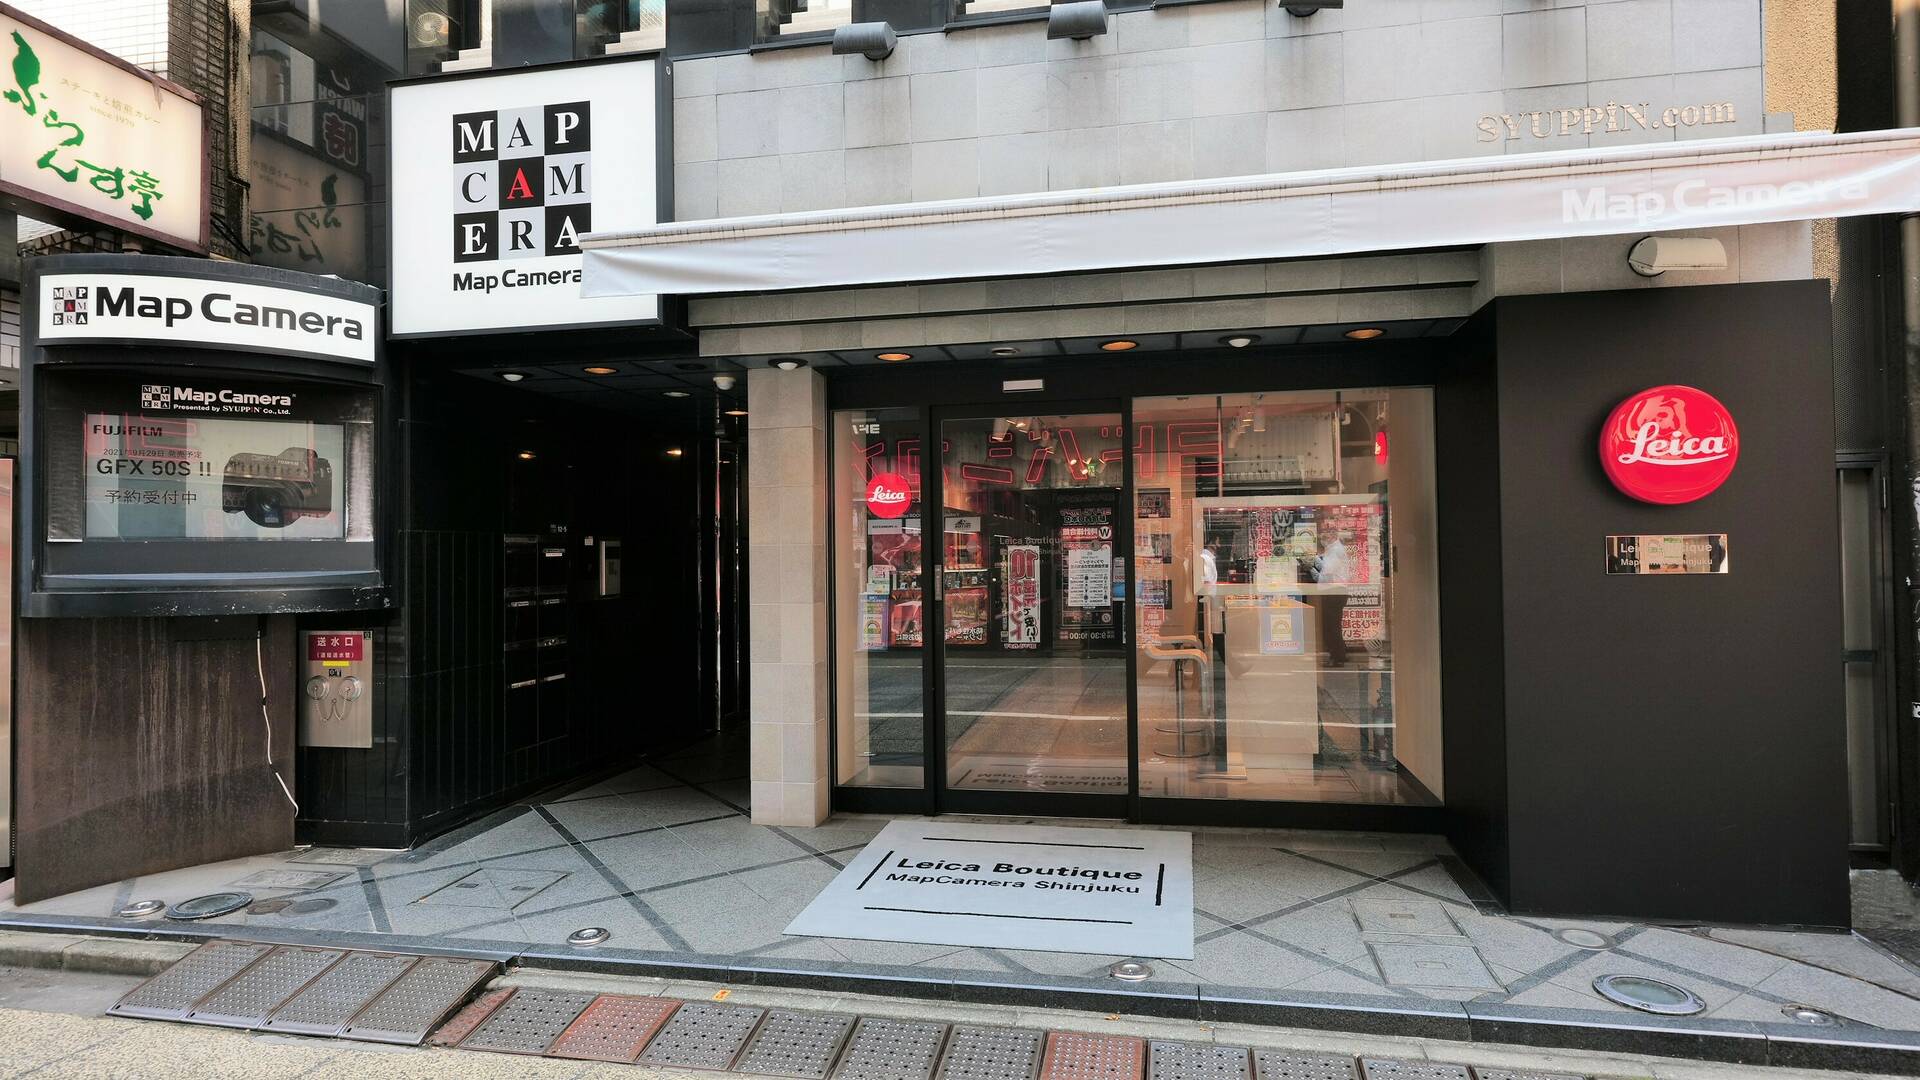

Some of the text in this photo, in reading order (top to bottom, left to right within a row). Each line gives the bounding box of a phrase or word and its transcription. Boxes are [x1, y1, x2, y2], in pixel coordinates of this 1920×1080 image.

[3, 28, 164, 221] ふらんす亭
[457, 112, 580, 153] MAP
[461, 163, 585, 203] CAM
[1562, 178, 1869, 227] Map Camera
[461, 216, 581, 255] ERA
[453, 268, 582, 294] Map Camera
[53, 286, 88, 299] MAP
[54, 301, 88, 312] CAM
[96, 286, 363, 341] Map Camera
[53, 312, 88, 326] ERA
[143, 385, 169, 393] MAP
[173, 387, 291, 406] Map Camera
[143, 401, 169, 409] ERA
[173, 403, 210, 411] Presented
[211, 405, 220, 413] by
[93, 424, 163, 437] FUJIFILM
[1617, 421, 1730, 466] Leica
[96, 458, 144, 476] GFX
[152, 460, 191, 476] 50S
[104, 489, 198, 505] 予約受付中
[868, 485, 906, 503] Leica
[1025, 536, 1063, 547] Boutiqu
[317, 636, 354, 646] 送水口
[896, 857, 1143, 882] Leica Boutique
[885, 873, 1141, 895] MapCamera Shinjuku
